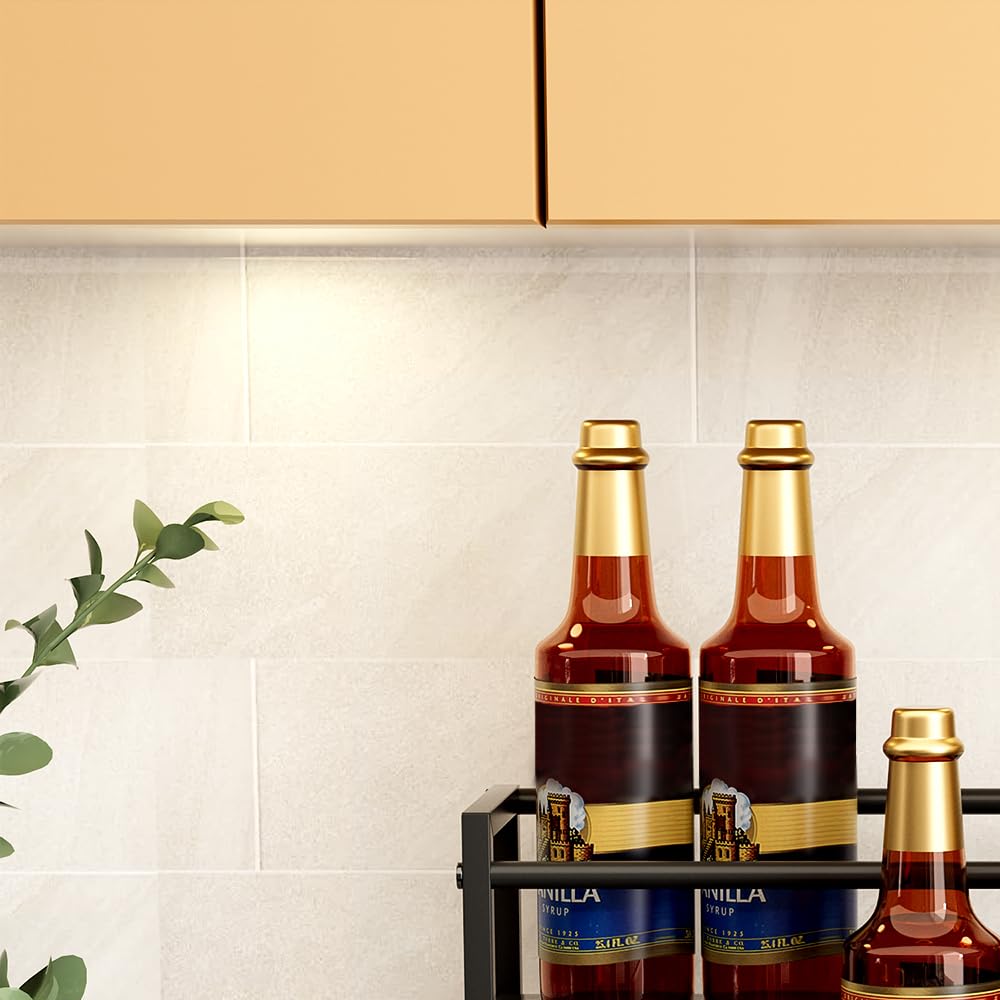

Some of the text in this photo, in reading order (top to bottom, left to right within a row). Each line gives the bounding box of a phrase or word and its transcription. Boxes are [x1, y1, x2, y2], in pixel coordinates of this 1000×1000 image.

[537, 889, 601, 903] ANILLA
[701, 889, 767, 903] ANILLA
[542, 904, 570, 917] SYRUP
[705, 903, 735, 917] SYRUP
[557, 929, 579, 938] 1925
[721, 929, 744, 938] 1925
